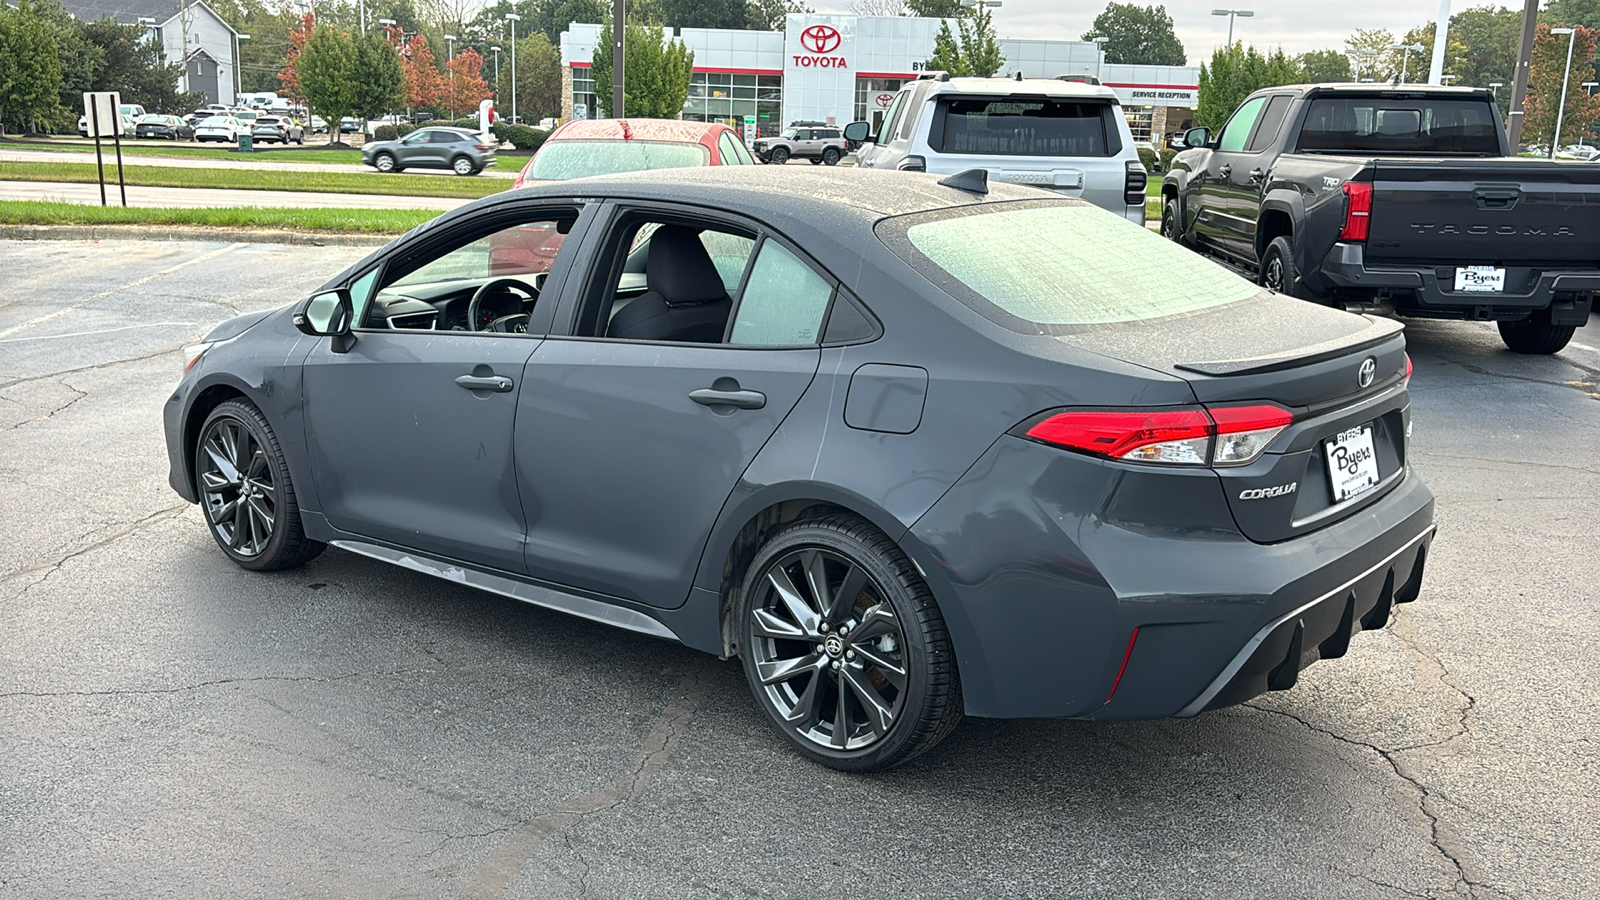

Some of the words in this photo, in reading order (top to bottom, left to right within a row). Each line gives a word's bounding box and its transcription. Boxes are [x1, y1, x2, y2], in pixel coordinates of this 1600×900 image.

[793, 55, 847, 69] TOYOTA
[1132, 91, 1157, 99] SERVICE
[1006, 174, 1049, 183] TOYOTA
[1323, 176, 1340, 187] TRD
[1410, 223, 1575, 236] TACOMA
[1460, 270, 1500, 284] Byers
[1330, 446, 1371, 475] Byers
[1239, 481, 1297, 500] COROLLA
